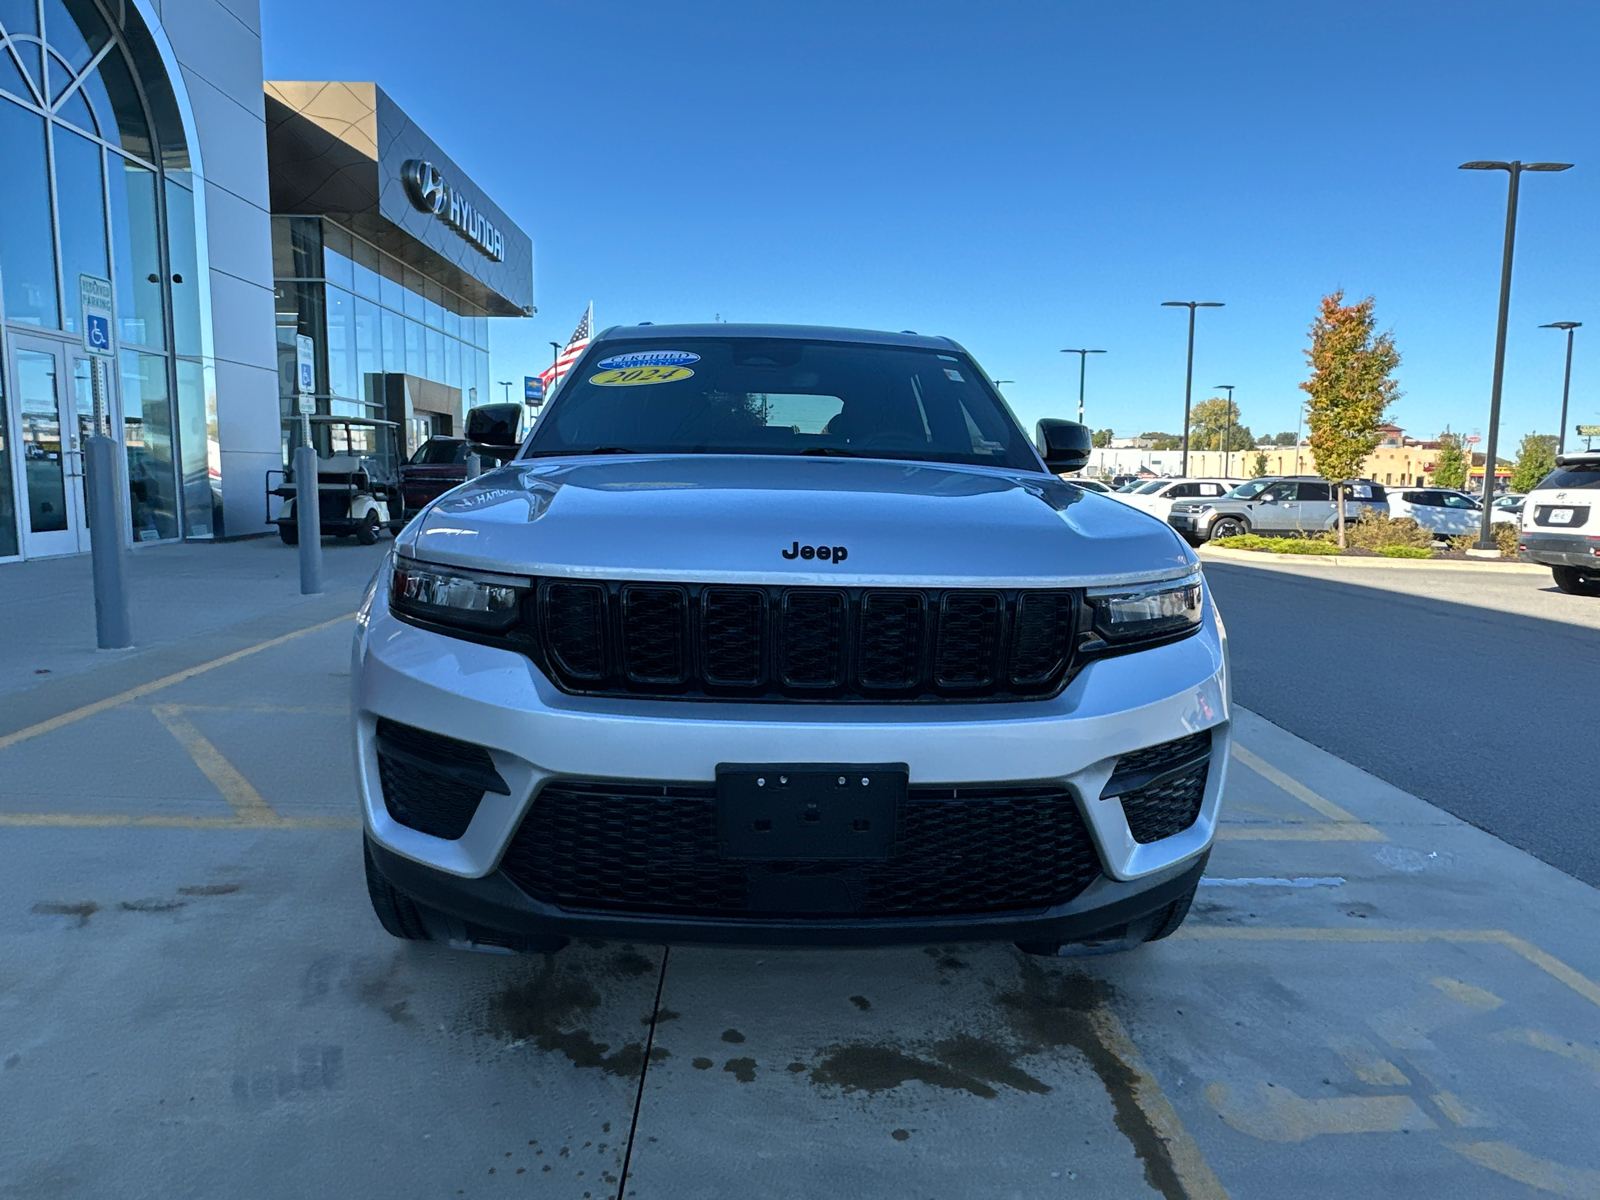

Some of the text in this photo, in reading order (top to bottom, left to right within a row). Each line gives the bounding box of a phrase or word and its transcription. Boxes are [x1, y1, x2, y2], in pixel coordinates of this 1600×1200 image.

[449, 187, 505, 262] HYUNDAI
[611, 352, 690, 362] CERTIFIED
[603, 368, 680, 384] 2024
[782, 541, 848, 564] Jeep
